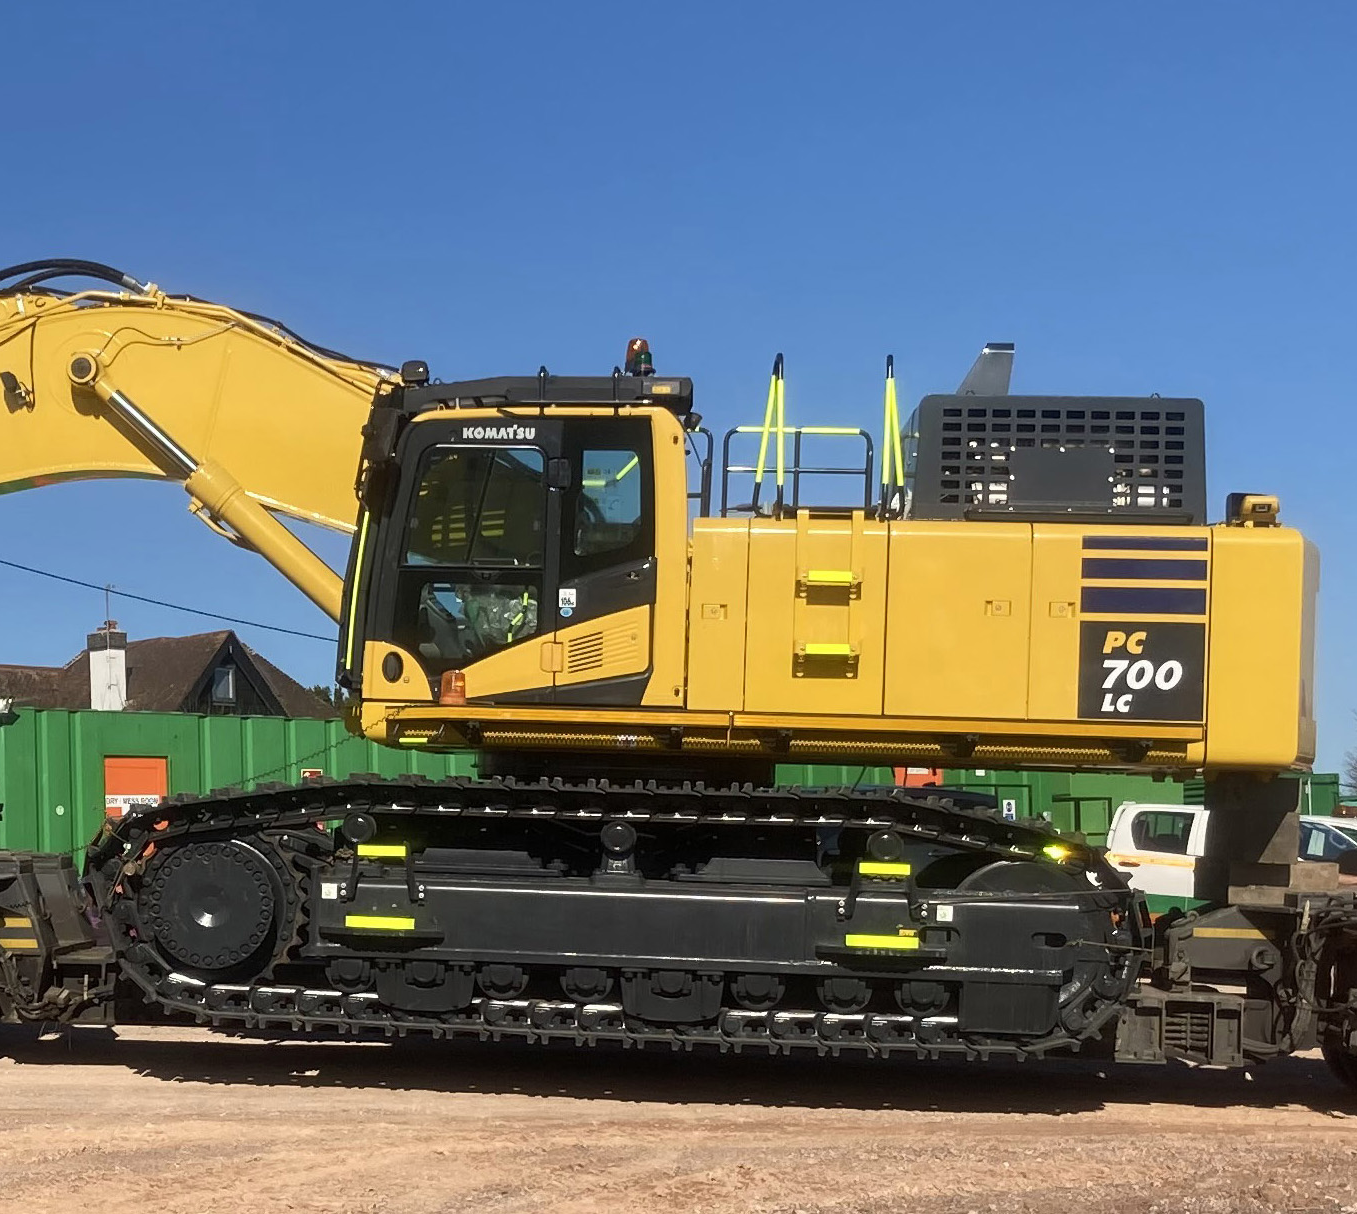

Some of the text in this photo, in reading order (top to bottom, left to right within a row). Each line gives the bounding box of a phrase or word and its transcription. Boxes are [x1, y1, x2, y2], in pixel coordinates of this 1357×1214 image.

[462, 424, 536, 440] KOMATSU
[1102, 631, 1148, 655] PC
[1101, 659, 1183, 691] 700
[1100, 693, 1134, 713] LC
